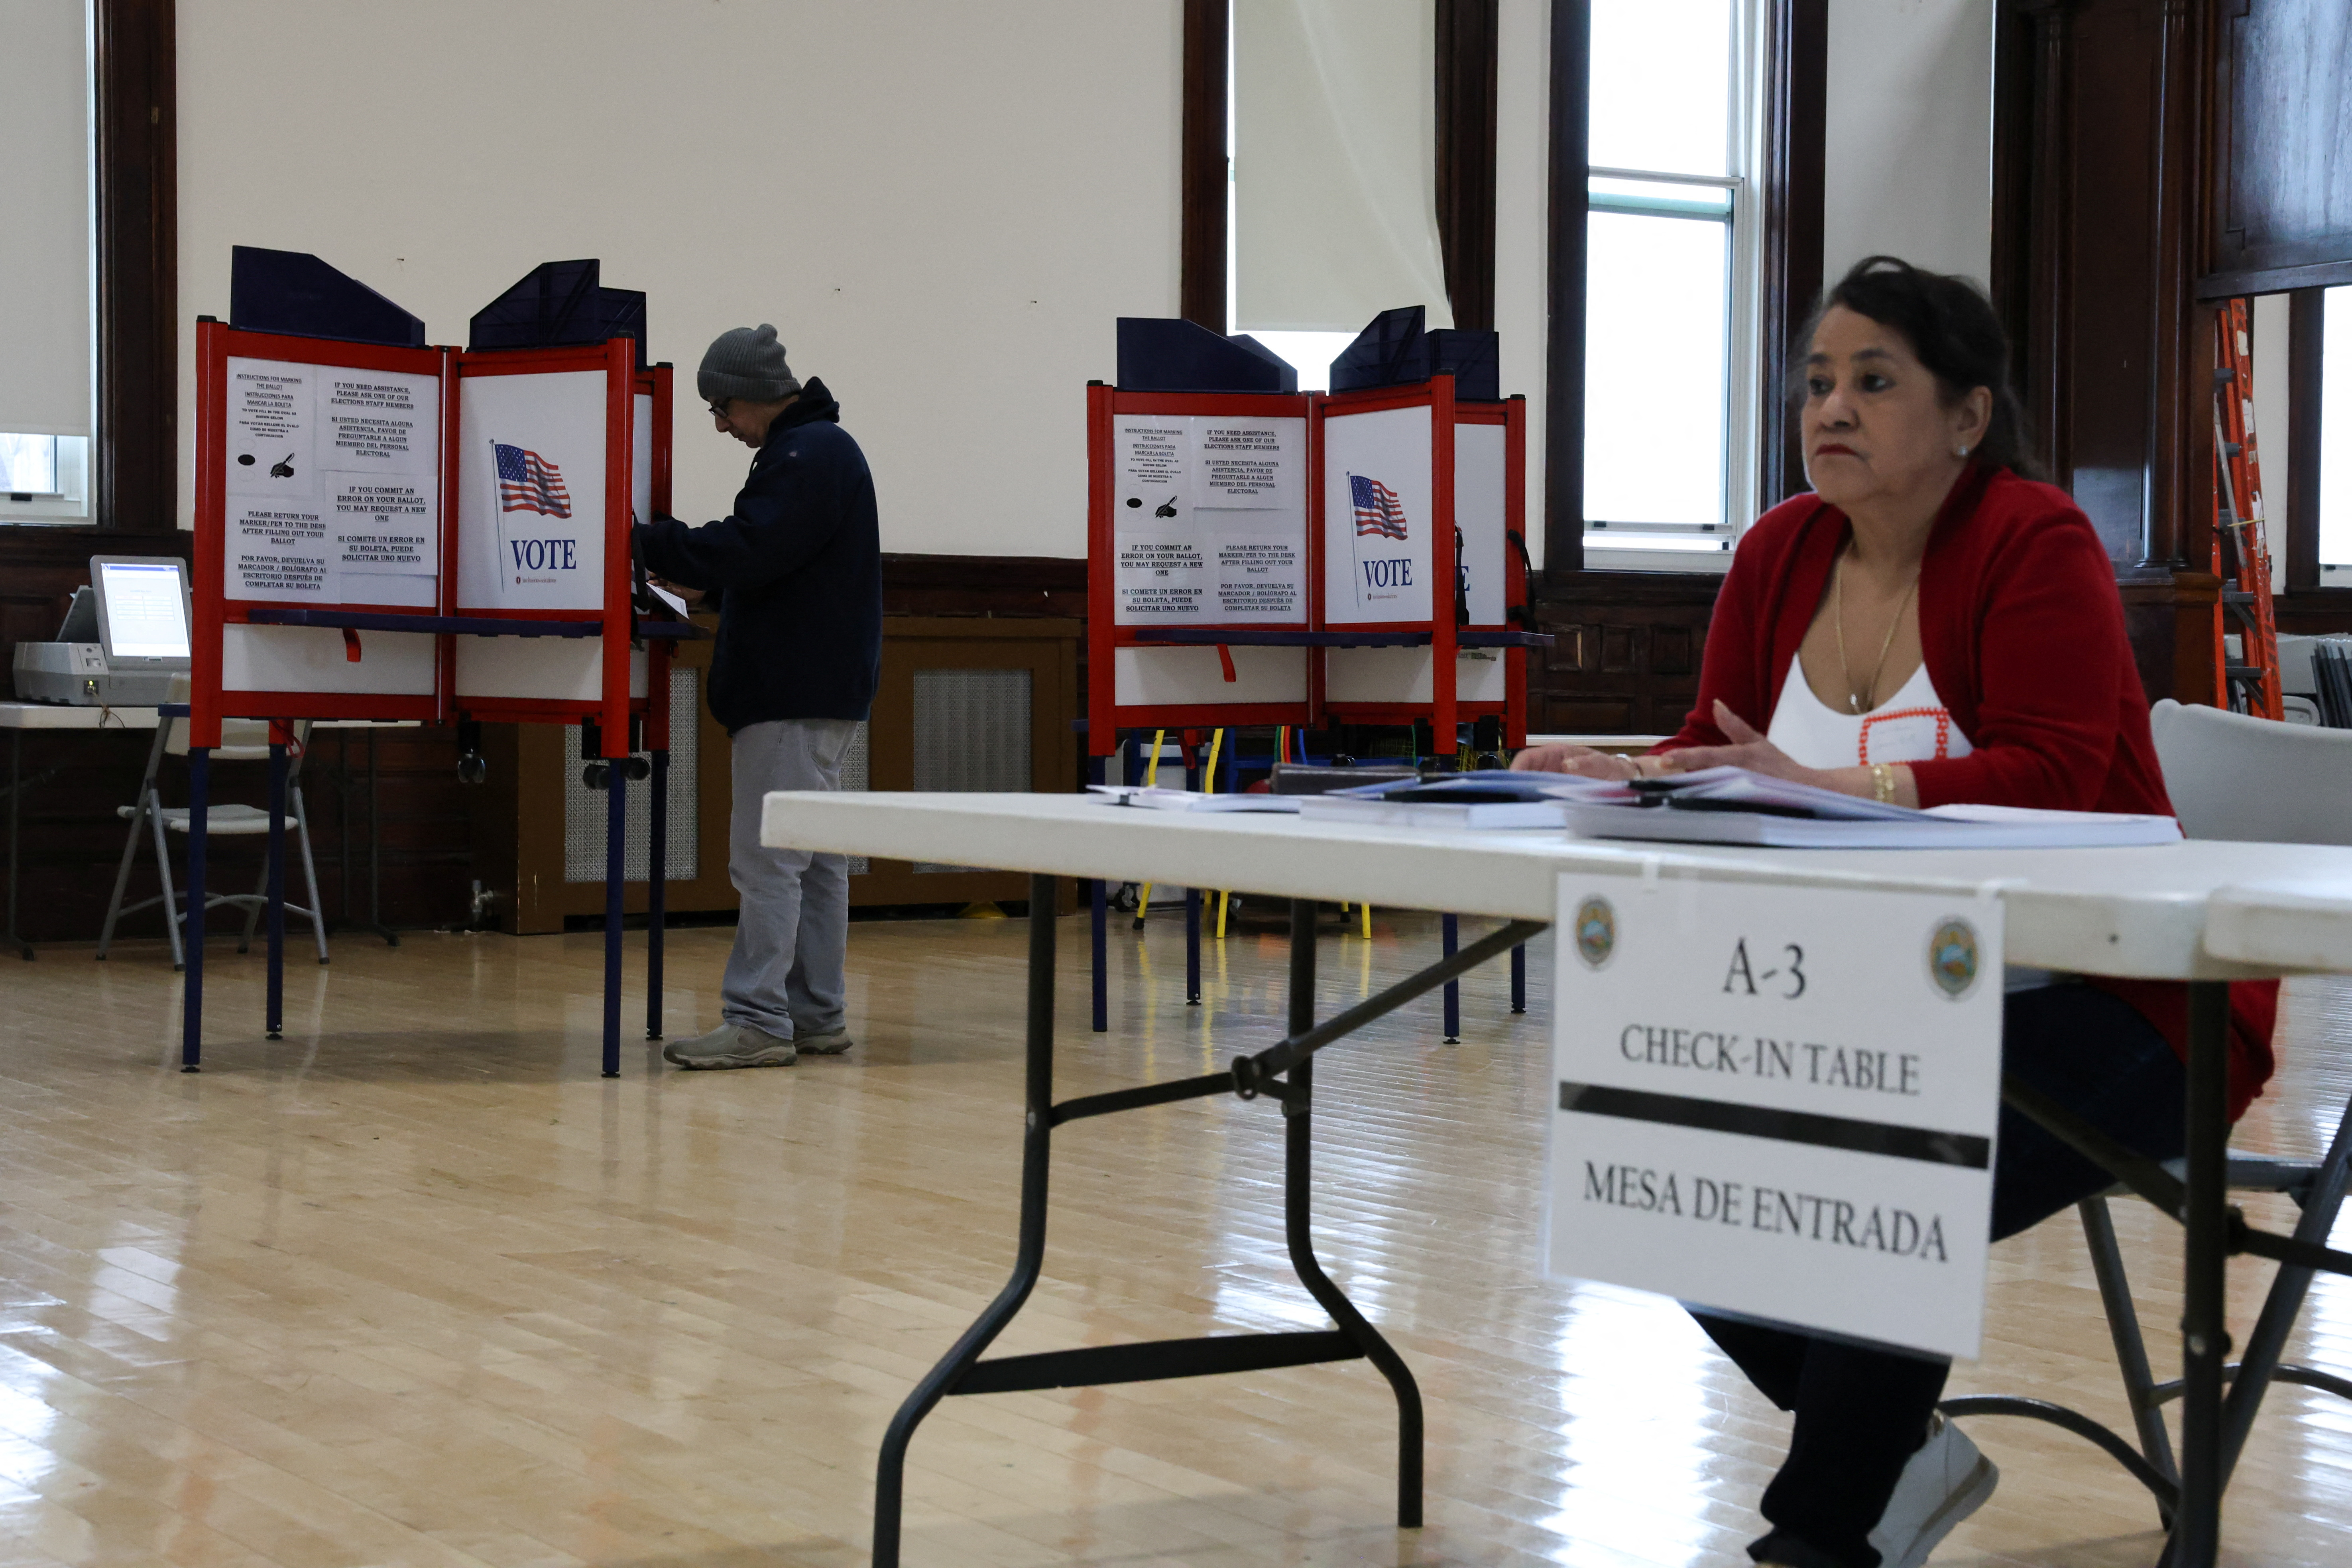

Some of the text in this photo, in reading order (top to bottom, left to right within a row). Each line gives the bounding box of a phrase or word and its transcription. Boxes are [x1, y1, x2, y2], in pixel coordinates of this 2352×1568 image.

[511, 540, 576, 570] VOTE
[1363, 559, 1412, 587] VOTE
[1723, 937, 1806, 998] A-3
[1620, 1023, 1920, 1096] CHECK-IN TABLE
[1584, 1161, 1948, 1262] MESA DE ENTRADA
